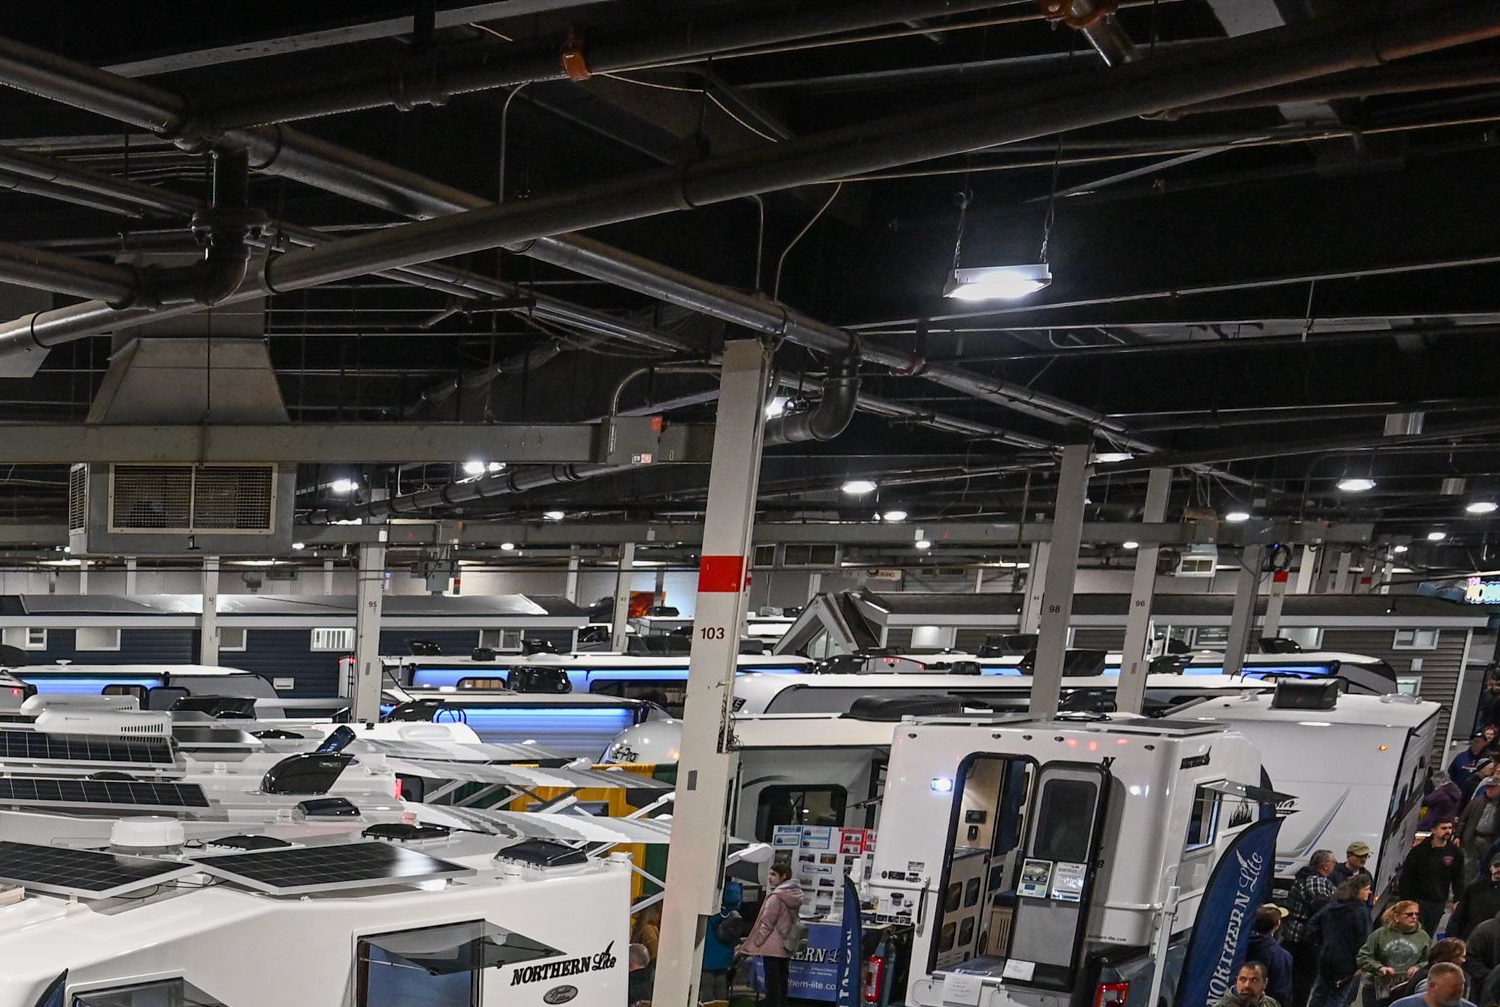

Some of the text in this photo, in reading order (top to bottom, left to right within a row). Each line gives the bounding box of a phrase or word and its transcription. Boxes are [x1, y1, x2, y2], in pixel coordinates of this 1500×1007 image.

[1049, 604, 1061, 613] 98
[700, 627, 725, 641] 103
[1236, 849, 1264, 892] Lite
[510, 940, 617, 986] NORTHERN Lite
